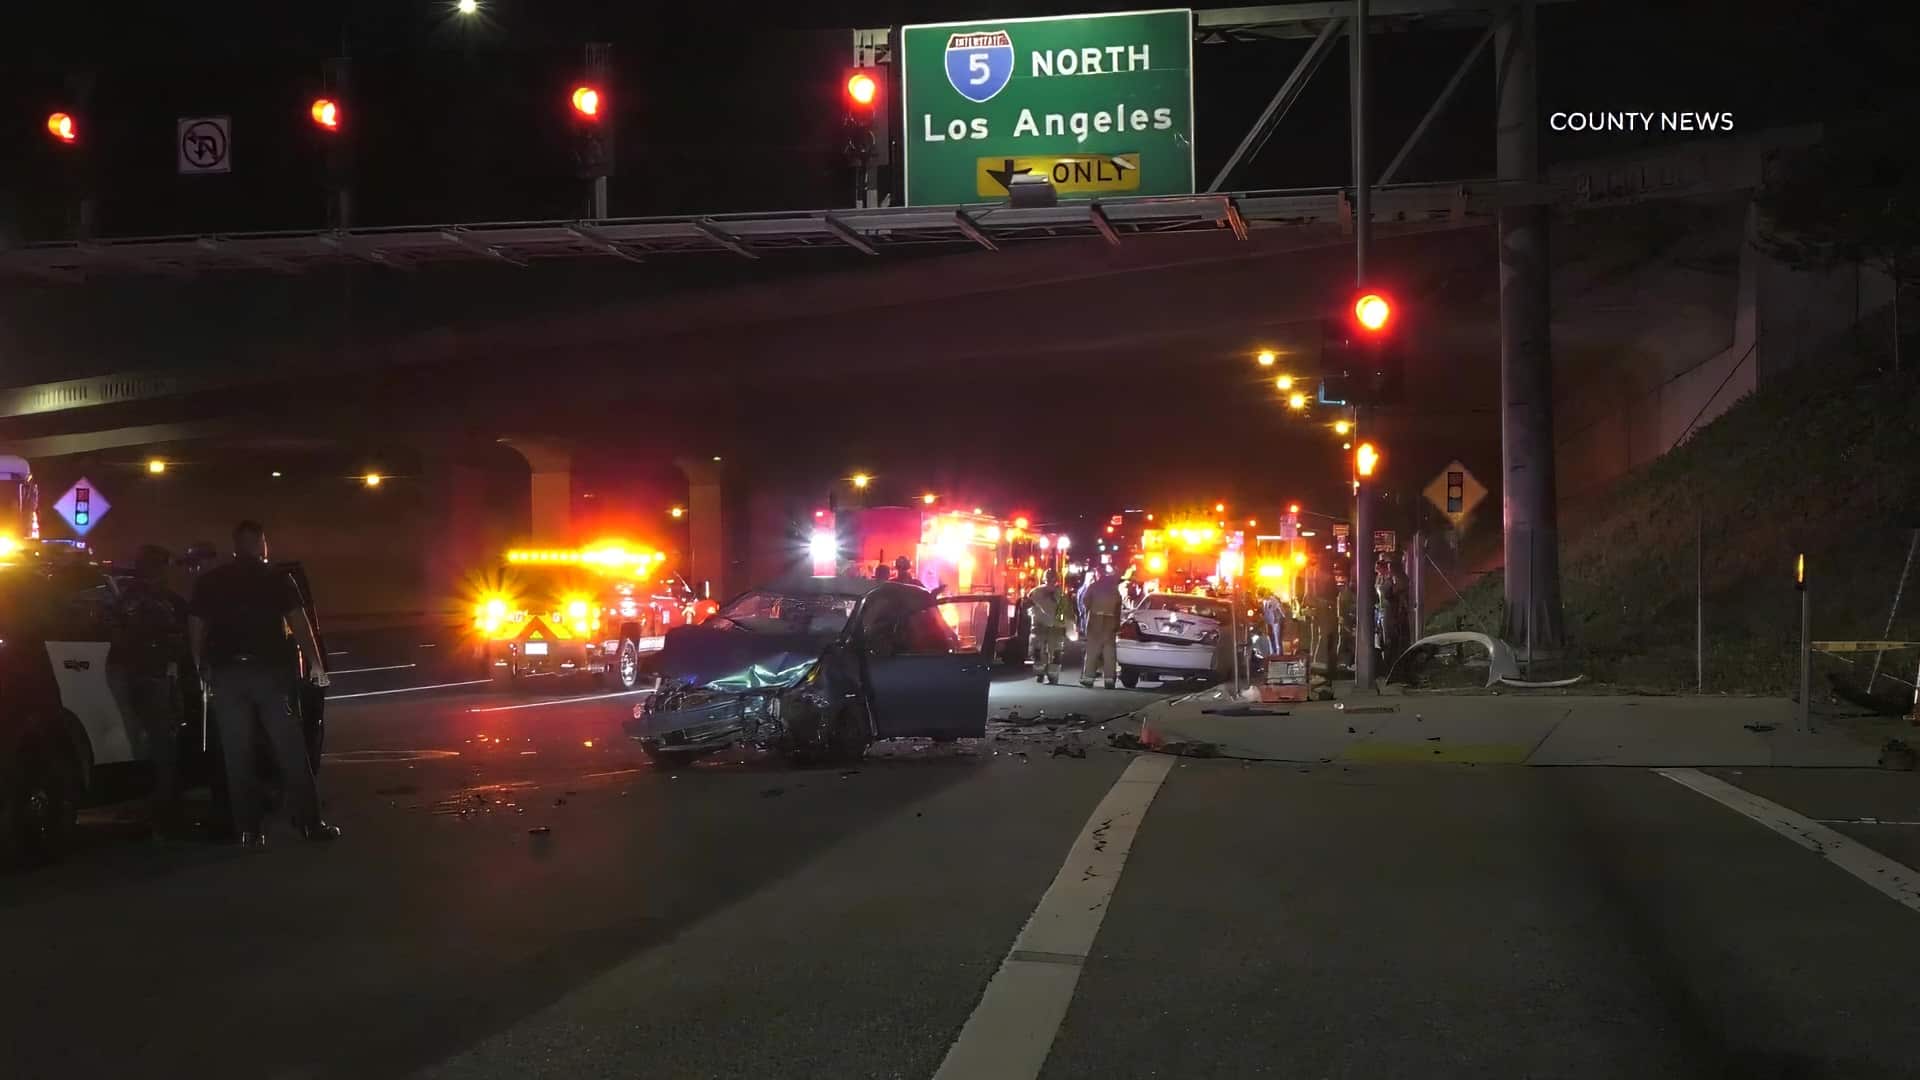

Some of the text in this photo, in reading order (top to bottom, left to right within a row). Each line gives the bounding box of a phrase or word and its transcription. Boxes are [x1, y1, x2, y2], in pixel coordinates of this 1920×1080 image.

[969, 53, 990, 85] 5
[1031, 44, 1150, 77] NORTH
[924, 104, 1173, 143] Los Angeles
[1053, 159, 1131, 183] ONLY
